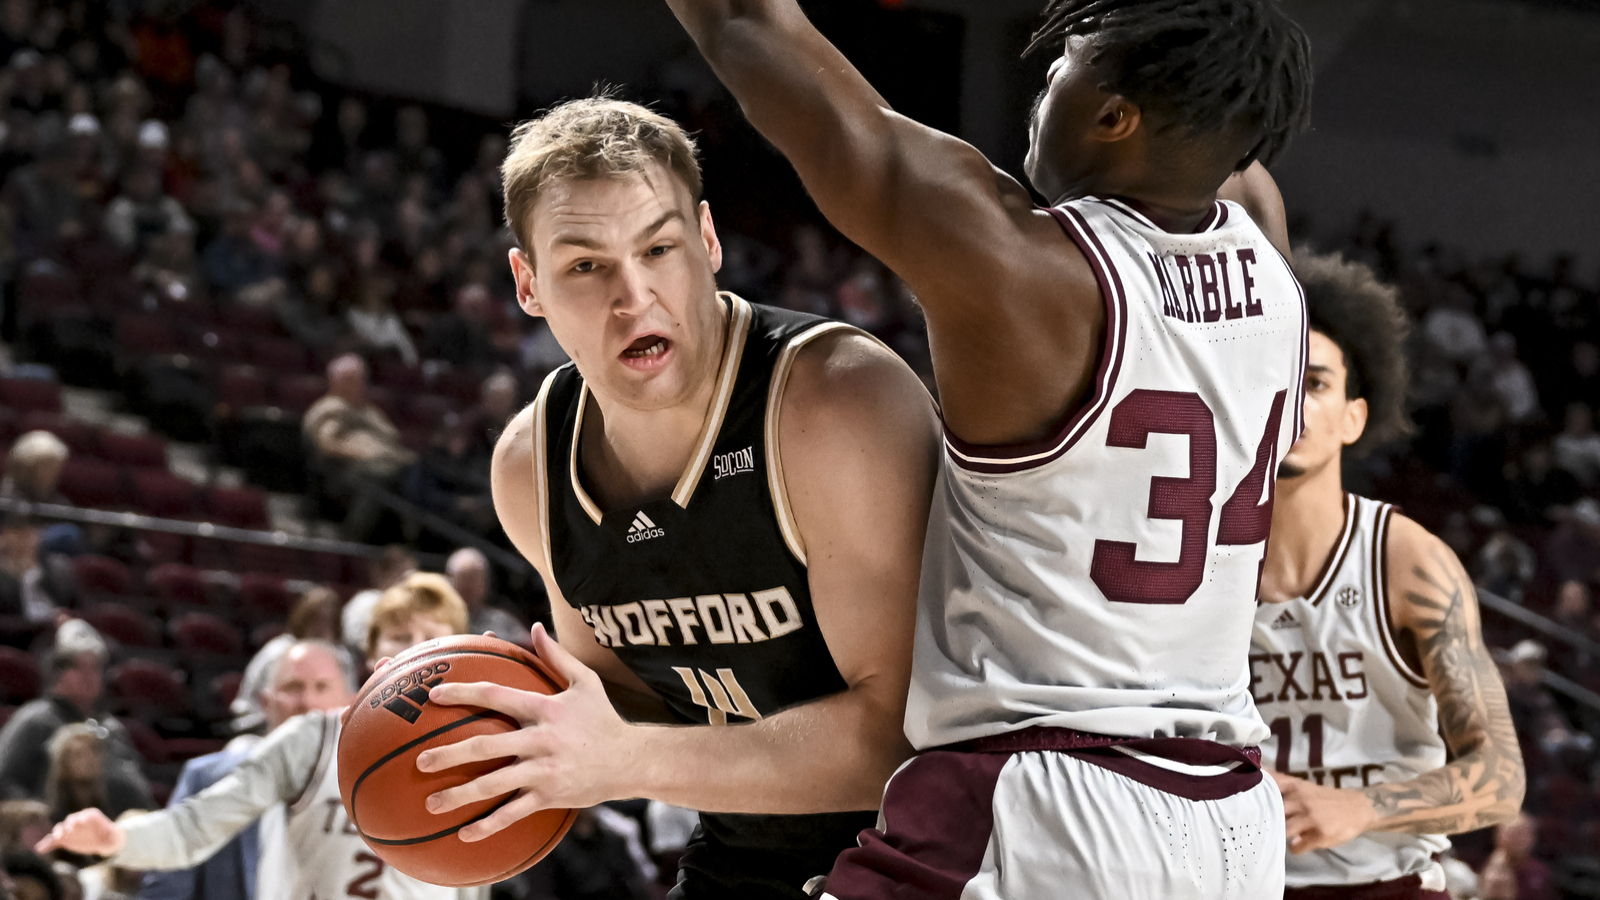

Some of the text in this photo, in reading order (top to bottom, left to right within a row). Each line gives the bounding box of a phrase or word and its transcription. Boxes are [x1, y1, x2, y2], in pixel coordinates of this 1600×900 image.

[713, 445, 754, 480] SOCON
[1089, 388, 1288, 604] 34
[626, 526, 665, 543] adidas
[580, 585, 803, 648] WOFFORD
[370, 662, 451, 709] adidas
[1248, 651, 1368, 705] EXAS
[1269, 713, 1323, 772] 11
[346, 851, 384, 899] 2
